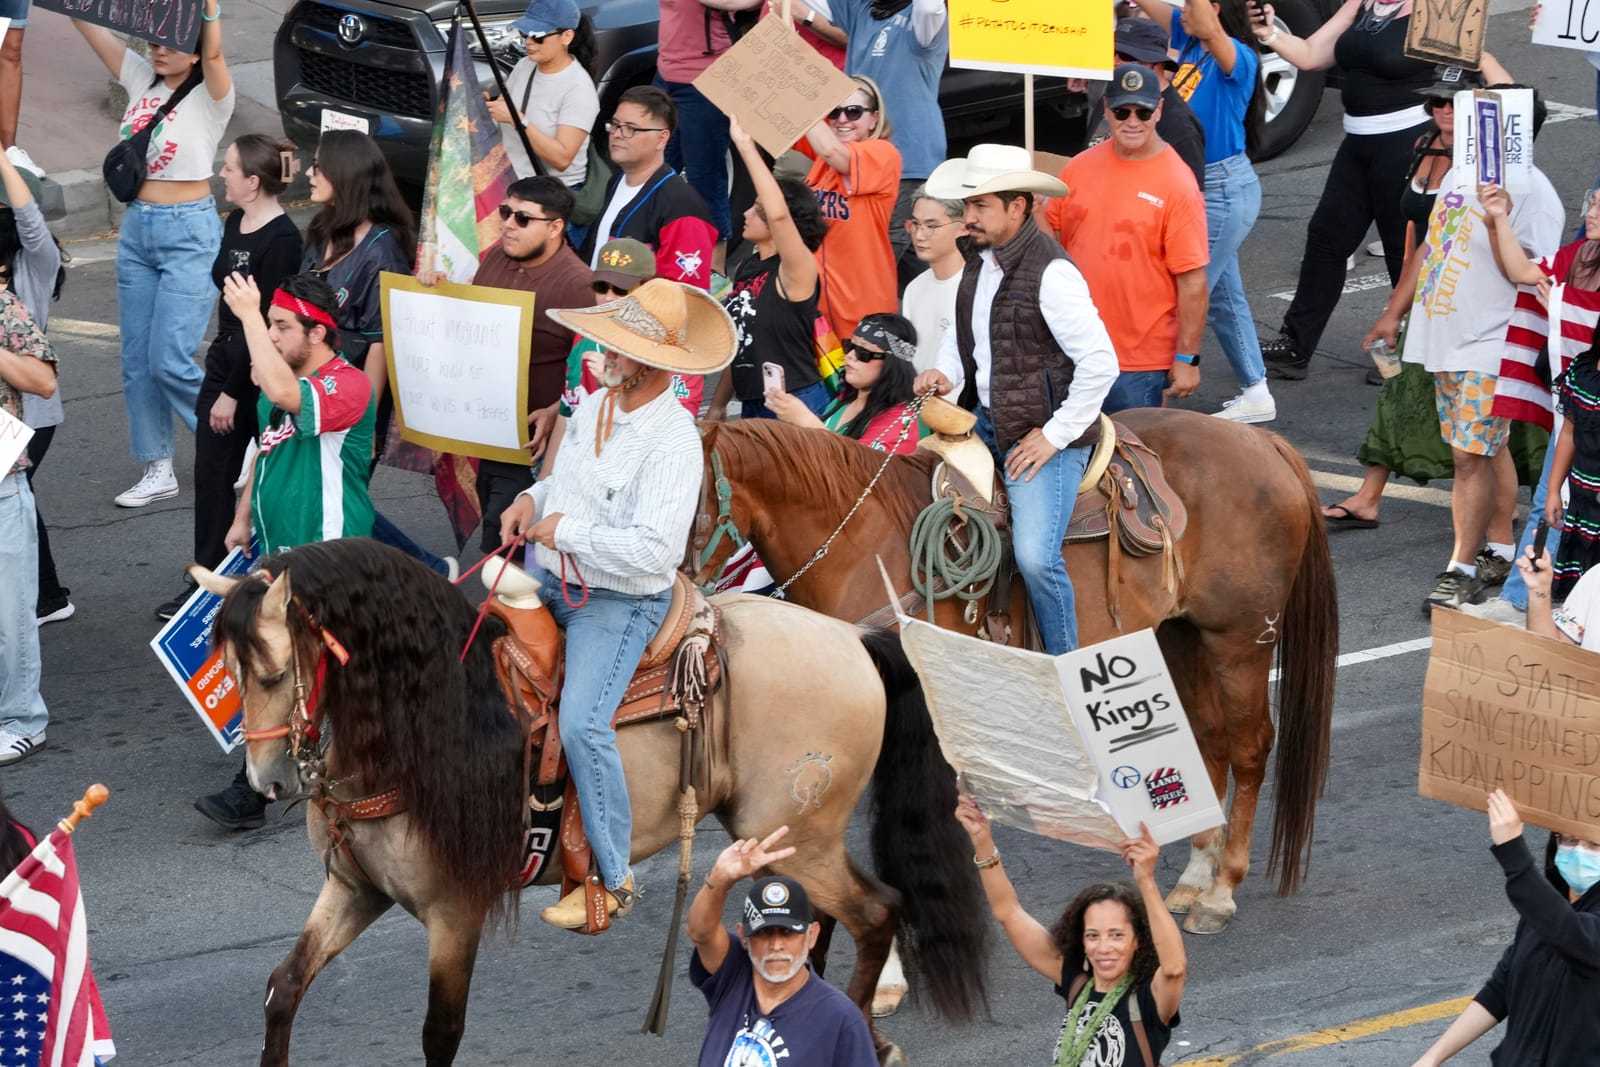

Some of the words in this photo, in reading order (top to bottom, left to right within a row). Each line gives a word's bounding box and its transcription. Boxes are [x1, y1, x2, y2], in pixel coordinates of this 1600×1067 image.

[205, 675, 236, 710] ERO
[1496, 654, 1596, 718] STATE
[1086, 693, 1170, 732] Kings
[1442, 688, 1600, 767] SANCTIONED
[1150, 774, 1180, 789] LAND
[1155, 790, 1184, 803] FREE
